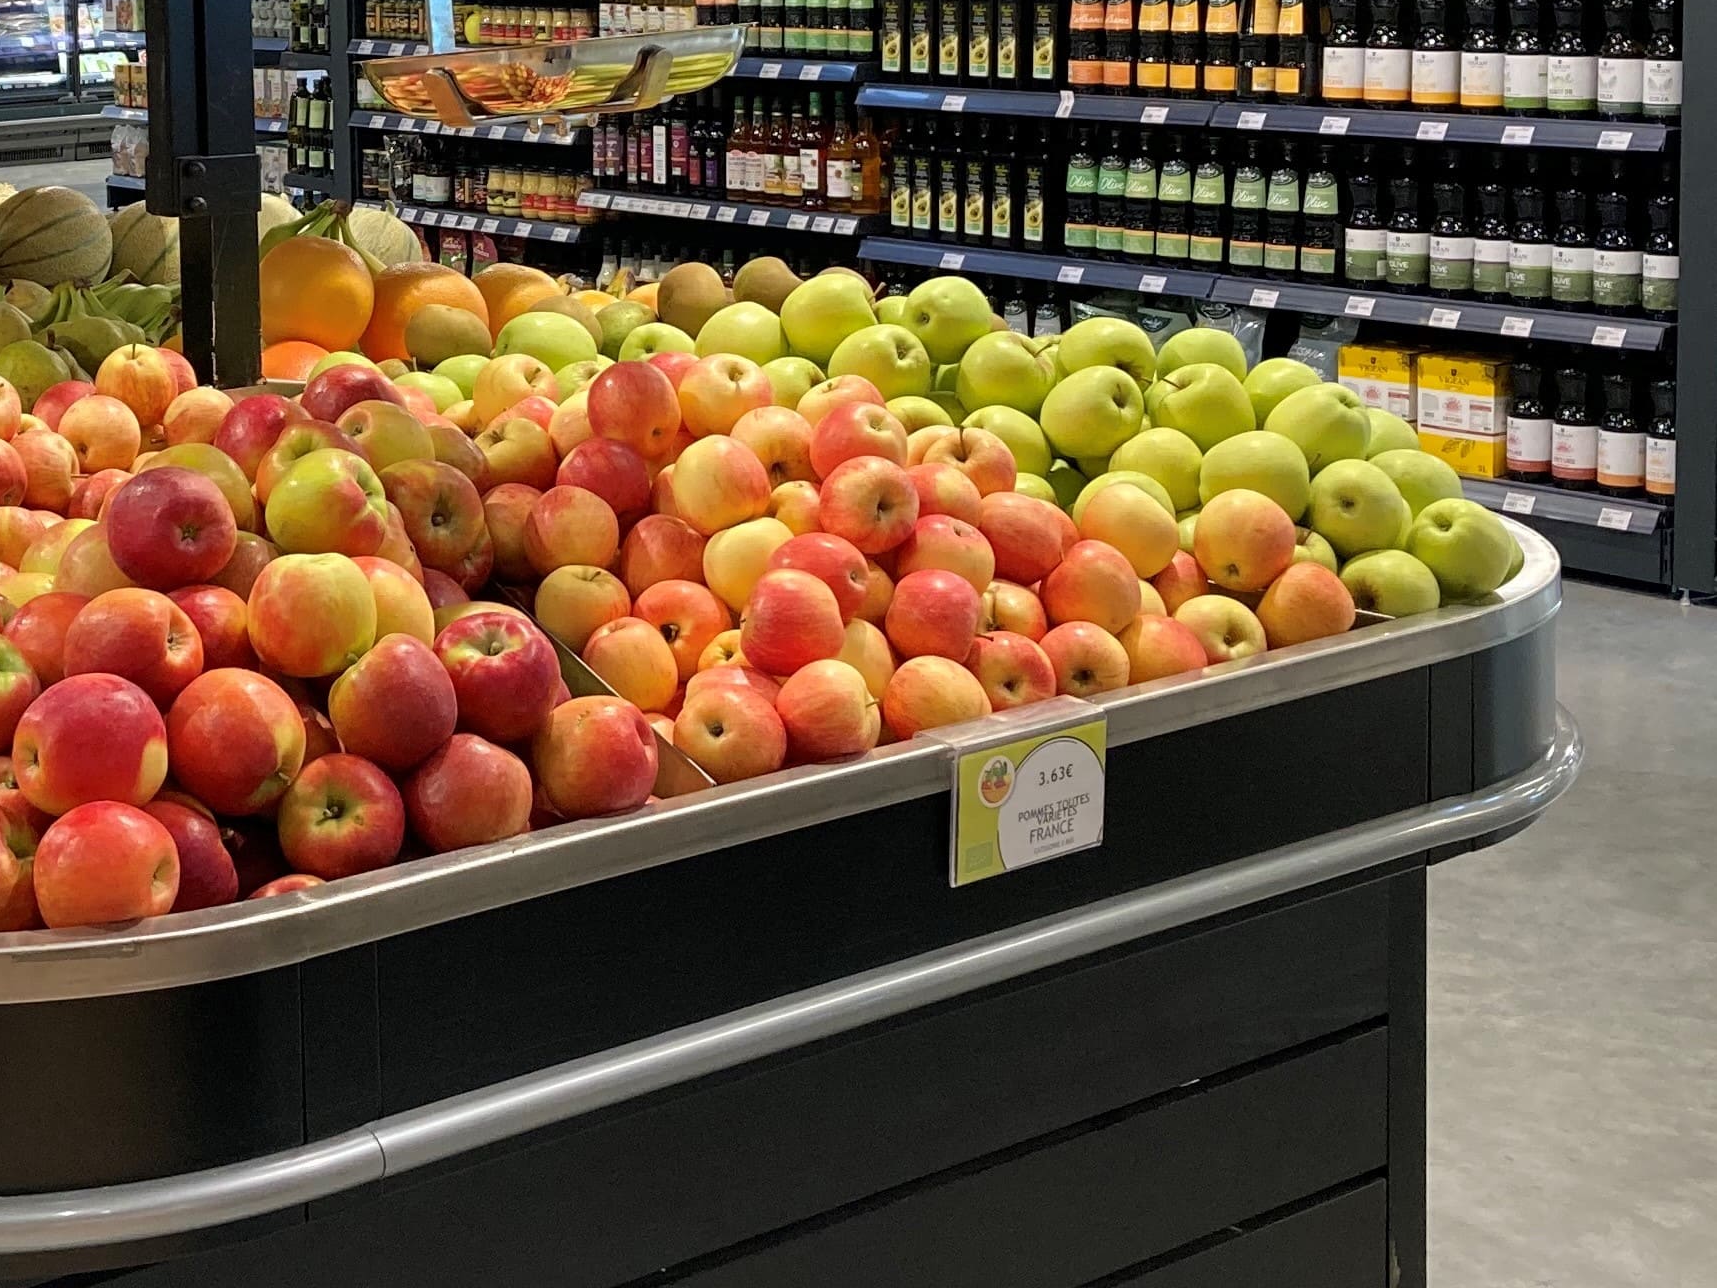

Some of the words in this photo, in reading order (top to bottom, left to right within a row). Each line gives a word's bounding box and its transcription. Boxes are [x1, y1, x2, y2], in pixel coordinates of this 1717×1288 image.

[1038, 764, 1074, 787] 3.63€
[1018, 800, 1055, 823] POMMES
[1056, 793, 1090, 813] TOUTES
[1029, 818, 1075, 843] FRANCE
